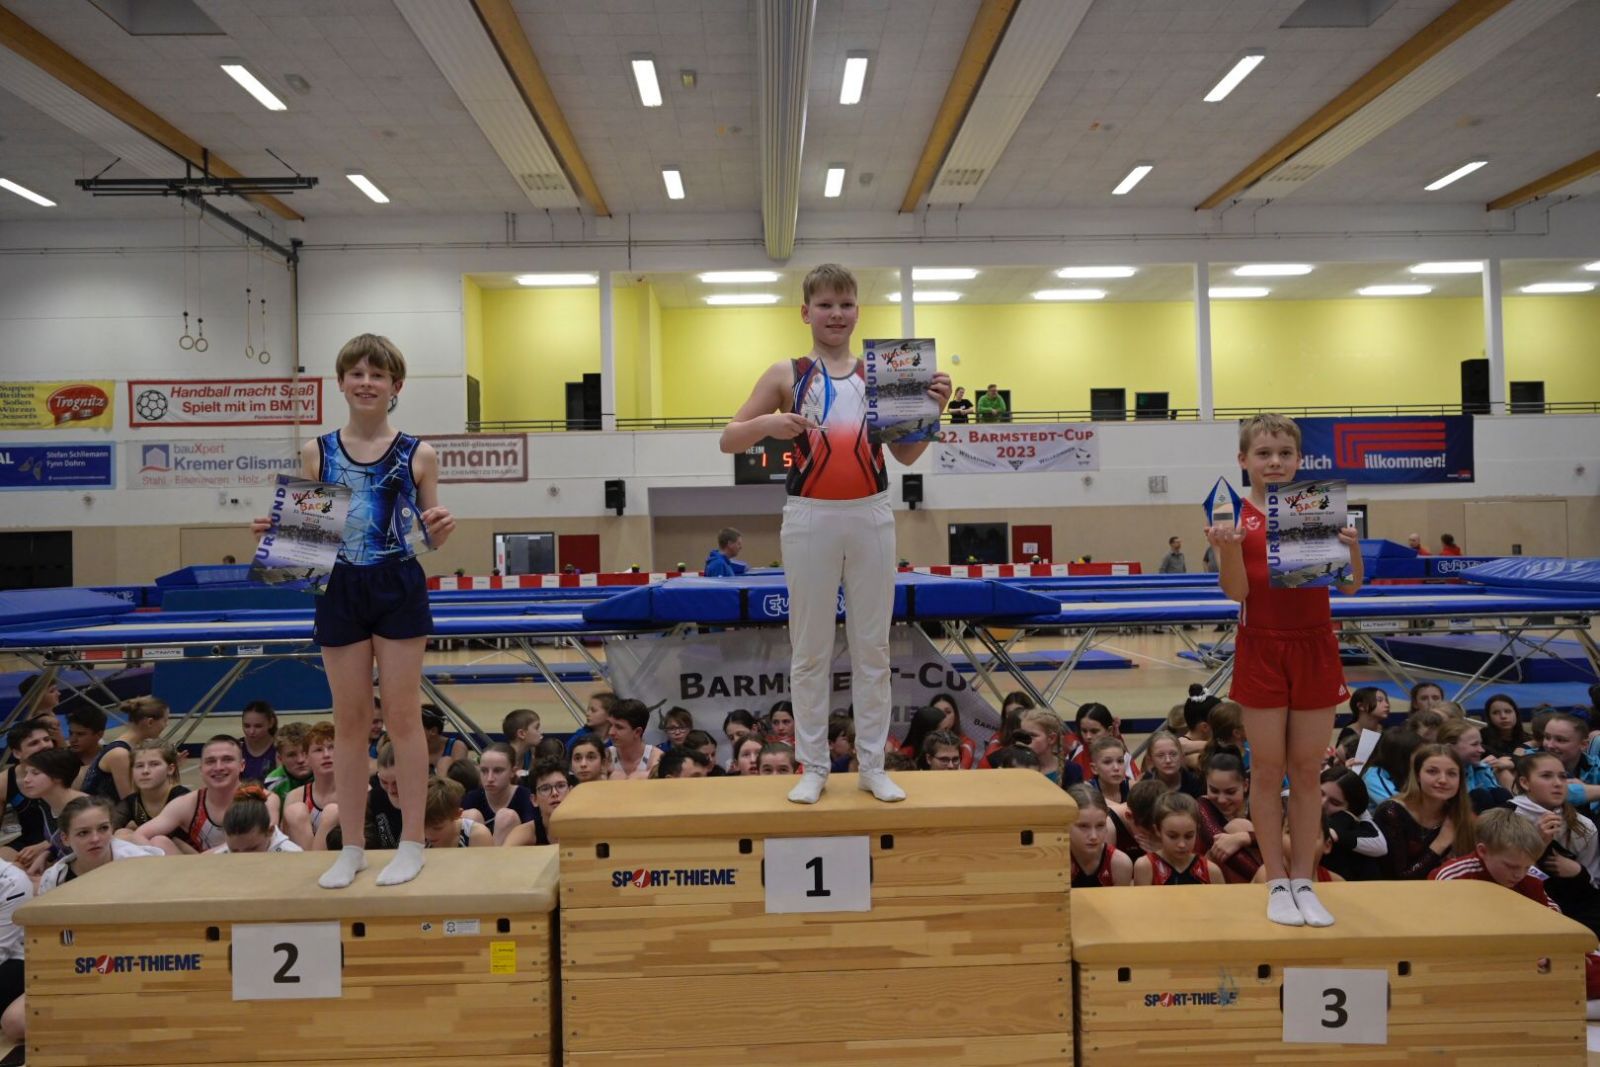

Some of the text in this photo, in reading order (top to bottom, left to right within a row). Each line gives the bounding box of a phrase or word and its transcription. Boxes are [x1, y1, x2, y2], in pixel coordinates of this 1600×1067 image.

[170, 386, 230, 398] Handball
[233, 386, 278, 397] macht
[55, 394, 105, 411] Trognitz
[182, 400, 315, 415] Spielt mit im BMV!
[939, 428, 1094, 443] 22. BARMSTEDT-CUP
[173, 443, 224, 454] bauXpert
[996, 446, 1036, 458] 2023
[174, 457, 233, 471] Kremer
[437, 449, 518, 467] mann
[1268, 484, 1281, 567] URKUNDE
[612, 868, 736, 888] SPORT-THIEME
[805, 856, 831, 897] 1
[75, 953, 202, 974] SPORT-THIEME
[272, 942, 301, 984] 2
[1144, 991, 1237, 1007] SPORT-THIEE
[1321, 987, 1349, 1028] 3
